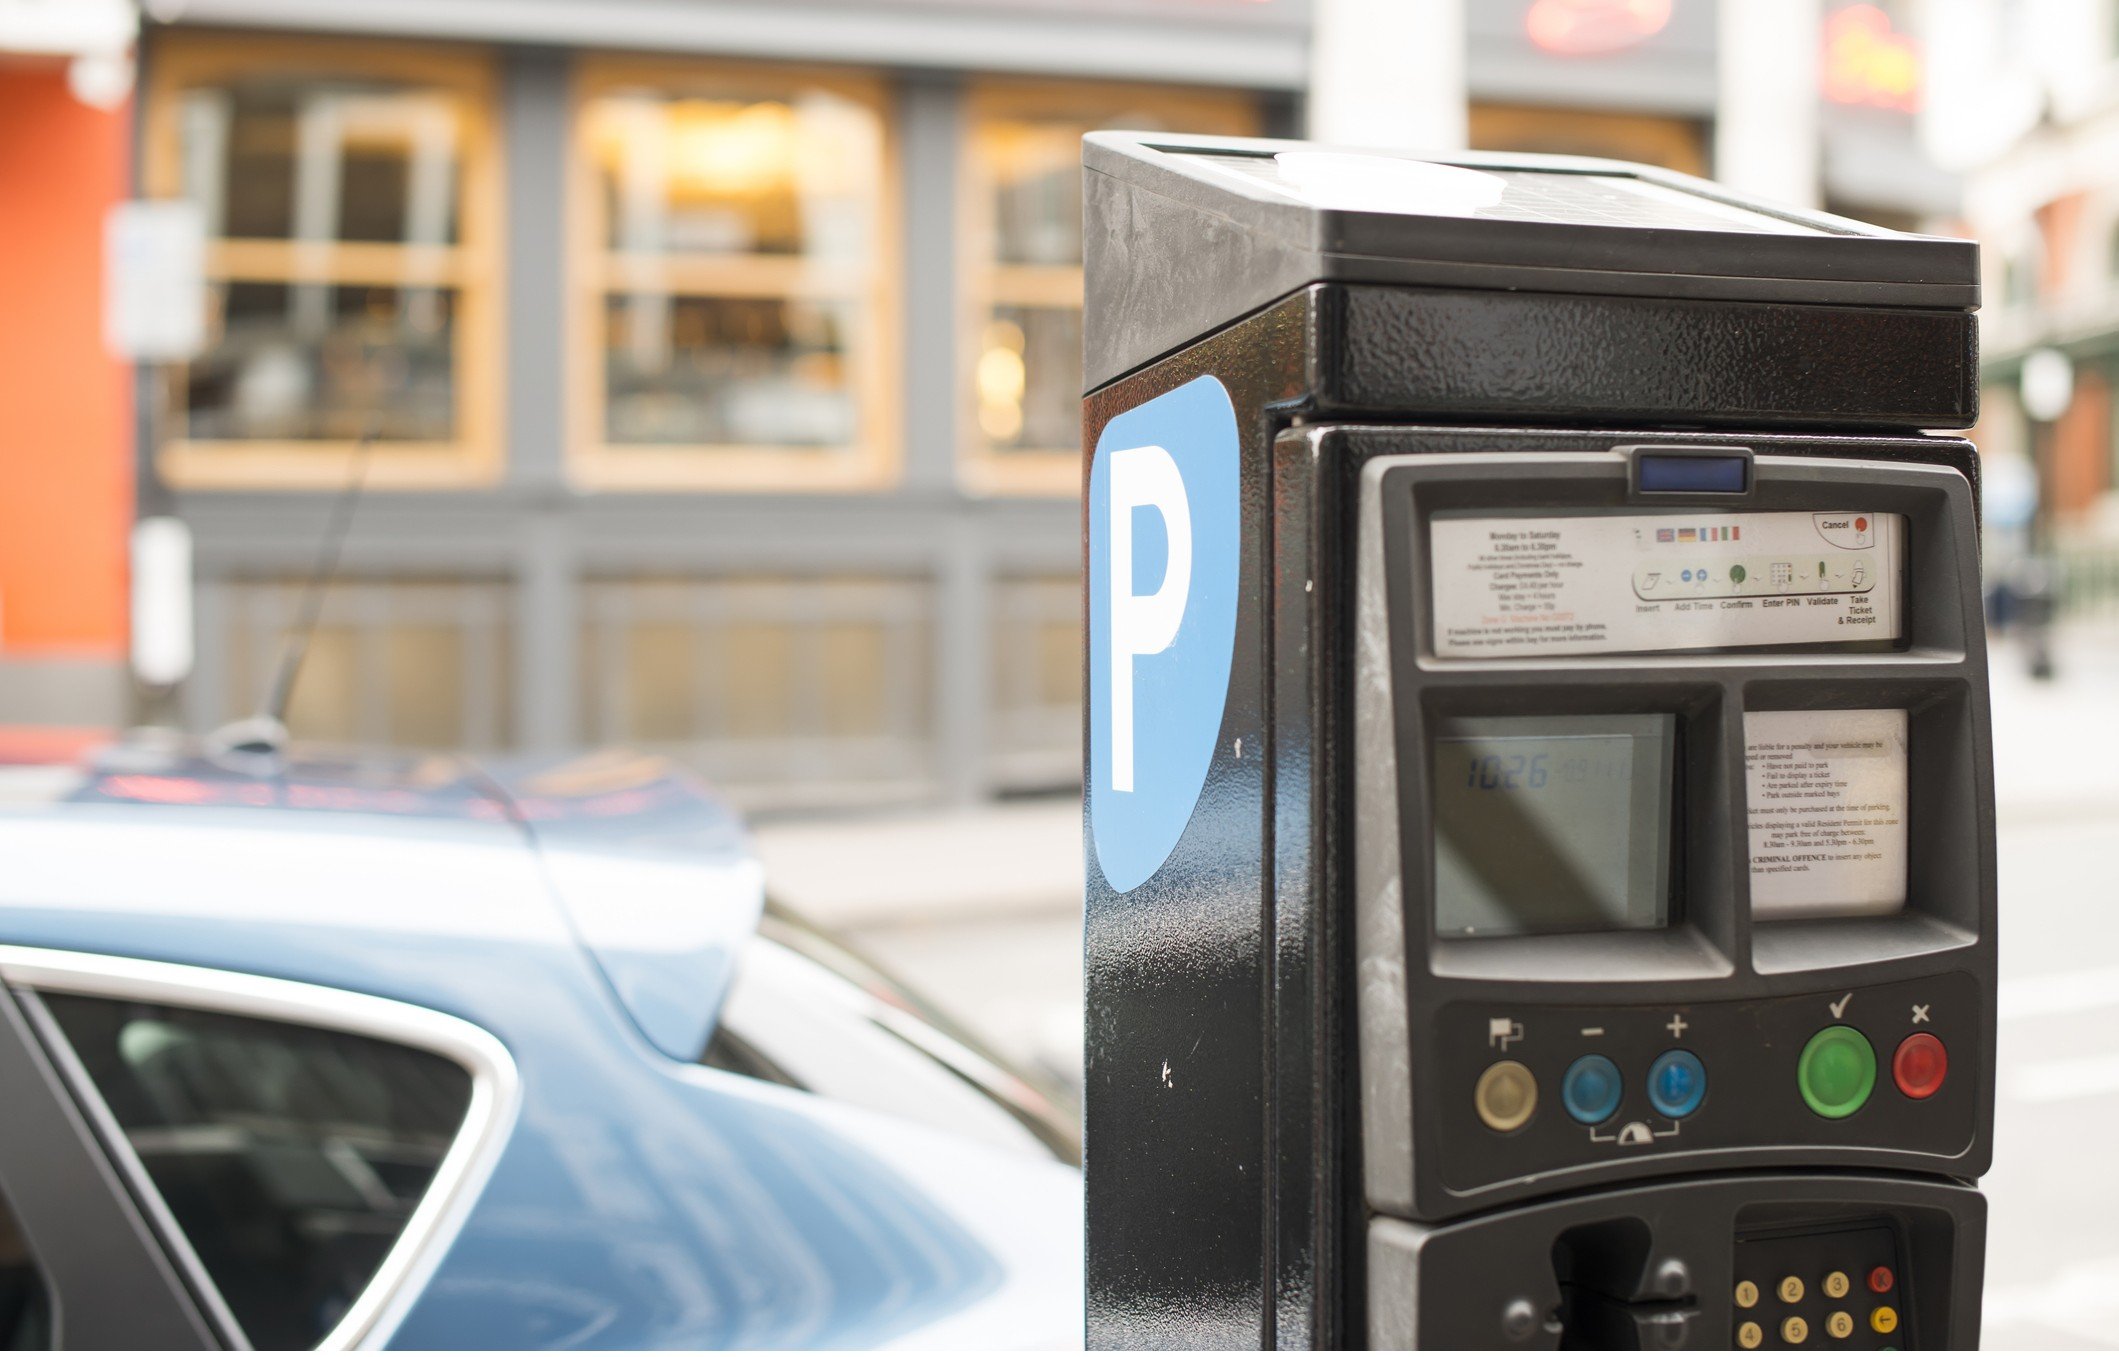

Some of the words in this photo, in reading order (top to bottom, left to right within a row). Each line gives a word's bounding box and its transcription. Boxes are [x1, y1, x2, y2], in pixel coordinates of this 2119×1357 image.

[1822, 520, 1849, 529] Cancel
[1529, 531, 1561, 540] Saturday
[1762, 598, 1784, 608] Enter
[1786, 598, 1801, 607] PIN
[1807, 597, 1839, 606] Validate
[1850, 595, 1869, 604] Take
[1635, 604, 1660, 613] Insert
[1674, 602, 1691, 611] Add
[1693, 602, 1714, 611] Time
[1719, 600, 1754, 609] Confirm
[1849, 606, 1873, 615] Ticket
[1110, 445, 1193, 792] P
[1838, 616, 1844, 625] &
[1846, 614, 1876, 625] Receipt
[1813, 742, 1825, 750] and
[1825, 743, 1839, 751] your
[1767, 752, 1793, 760] removed
[1815, 761, 1829, 770] park
[1787, 771, 1807, 780] display
[1813, 770, 1831, 778] ticket
[1778, 781, 1799, 790] parked
[1815, 780, 1833, 789] expiry
[1834, 780, 1848, 788] time
[1766, 791, 1780, 799] Park
[1781, 790, 1803, 798] outside
[1804, 790, 1826, 798] marked
[1798, 805, 1828, 815] purchased
[1846, 803, 1859, 811] time
[1843, 818, 1863, 826] Permit
[1784, 830, 1798, 839] park
[1752, 855, 1791, 864] CRIMINAL
[1792, 853, 1827, 862] OFFENCE
[1766, 863, 1792, 874] specified
[1788, 1282, 1798, 1297] 2
[1833, 1277, 1843, 1292] 3
[1744, 1328, 1755, 1342] 4
[1791, 1323, 1801, 1338] 5
[1837, 1317, 1847, 1332] 6
